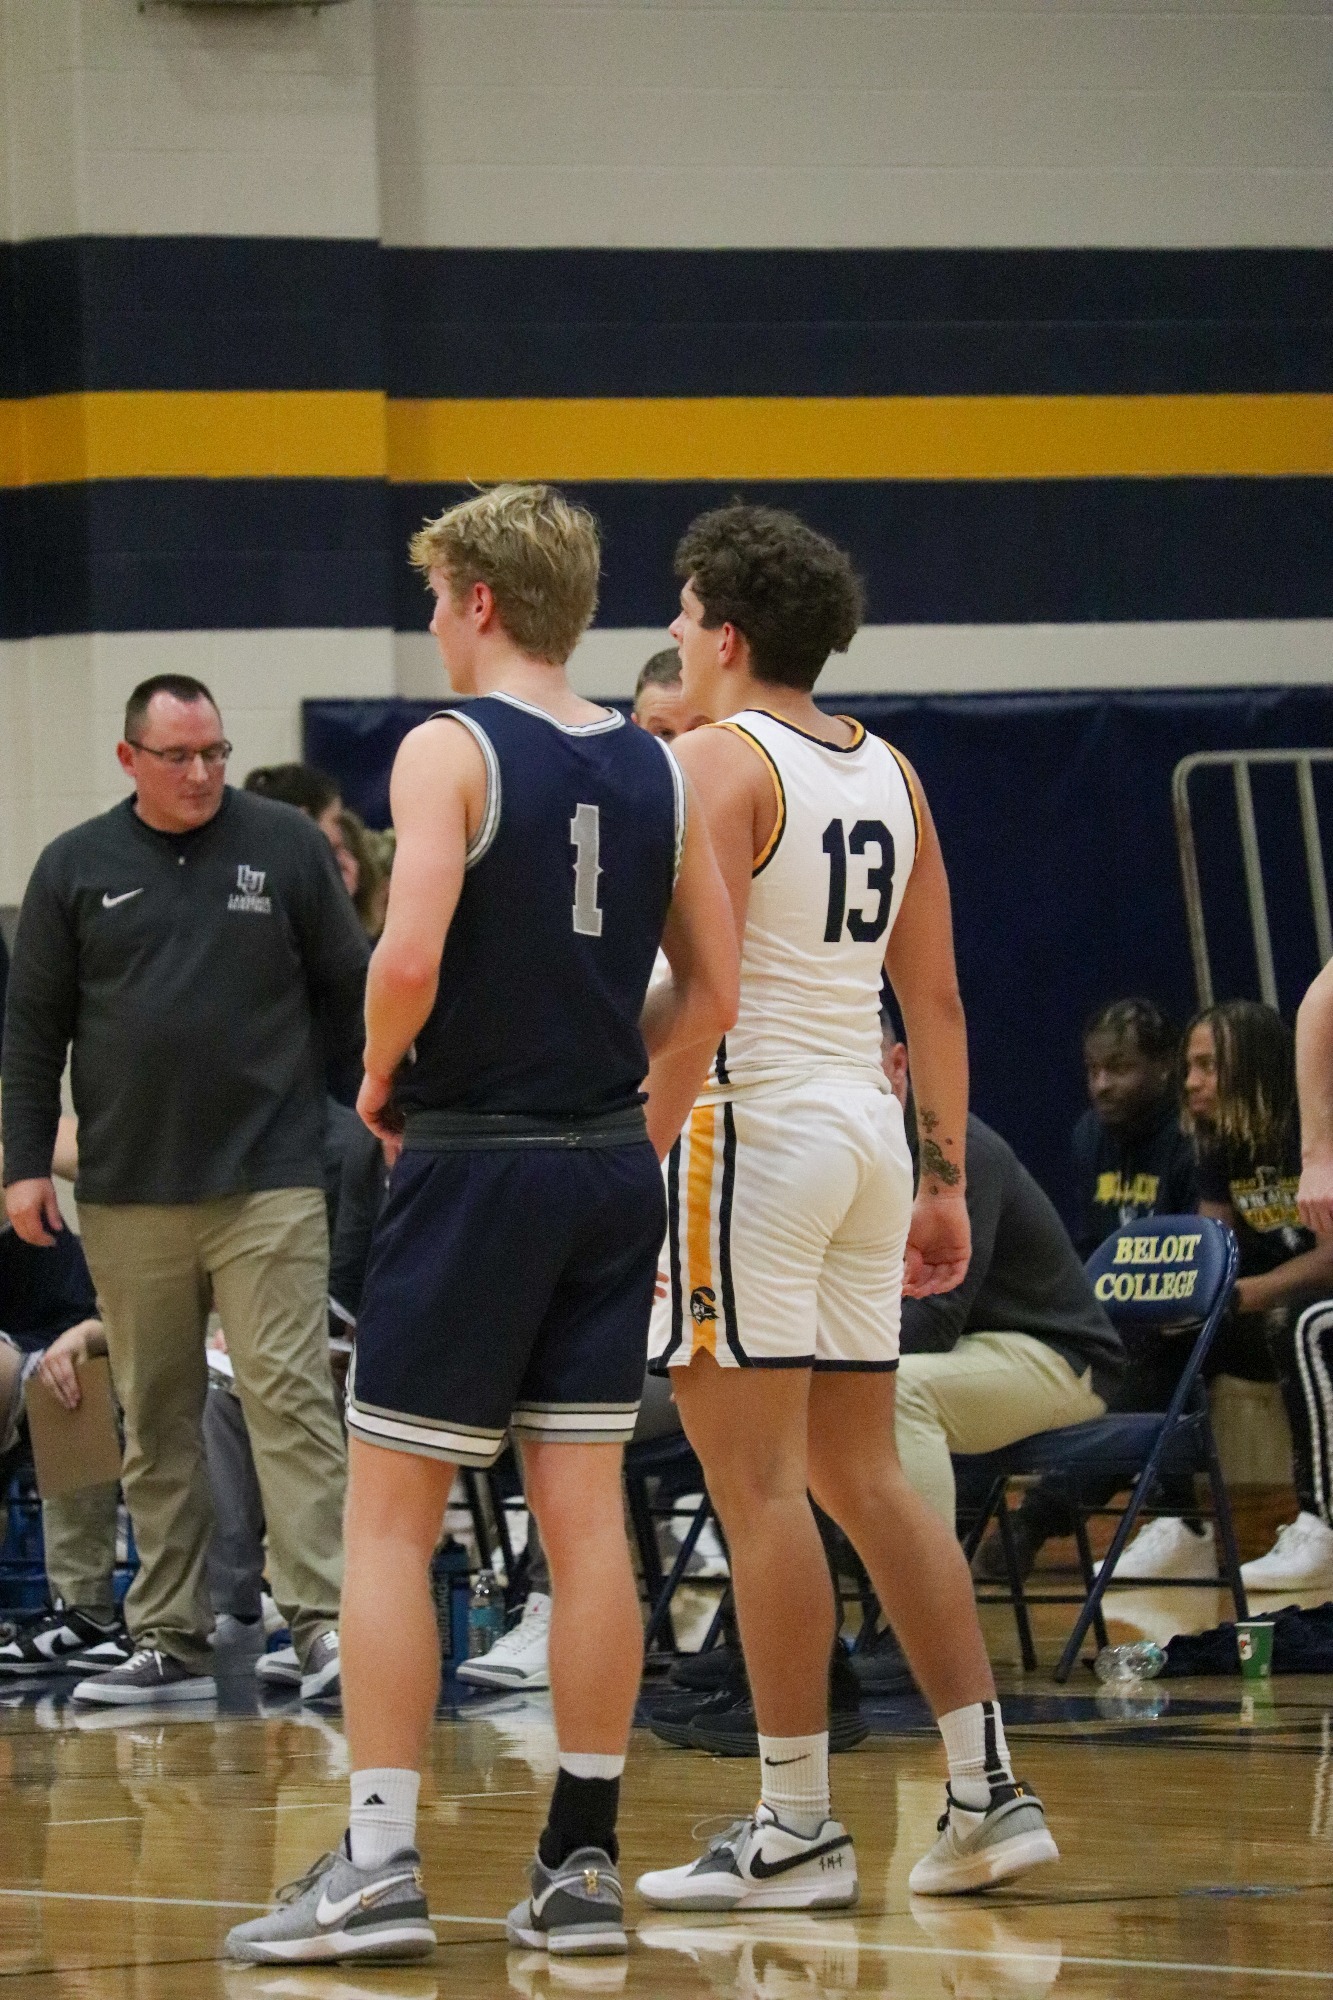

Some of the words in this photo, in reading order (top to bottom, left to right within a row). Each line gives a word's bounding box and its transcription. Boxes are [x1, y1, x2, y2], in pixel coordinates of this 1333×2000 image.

[570, 802, 603, 937] 1
[822, 818, 896, 943] 13
[1094, 1269, 1199, 1302] COLLEGE
[1112, 1234, 1202, 1265] BELOIT
